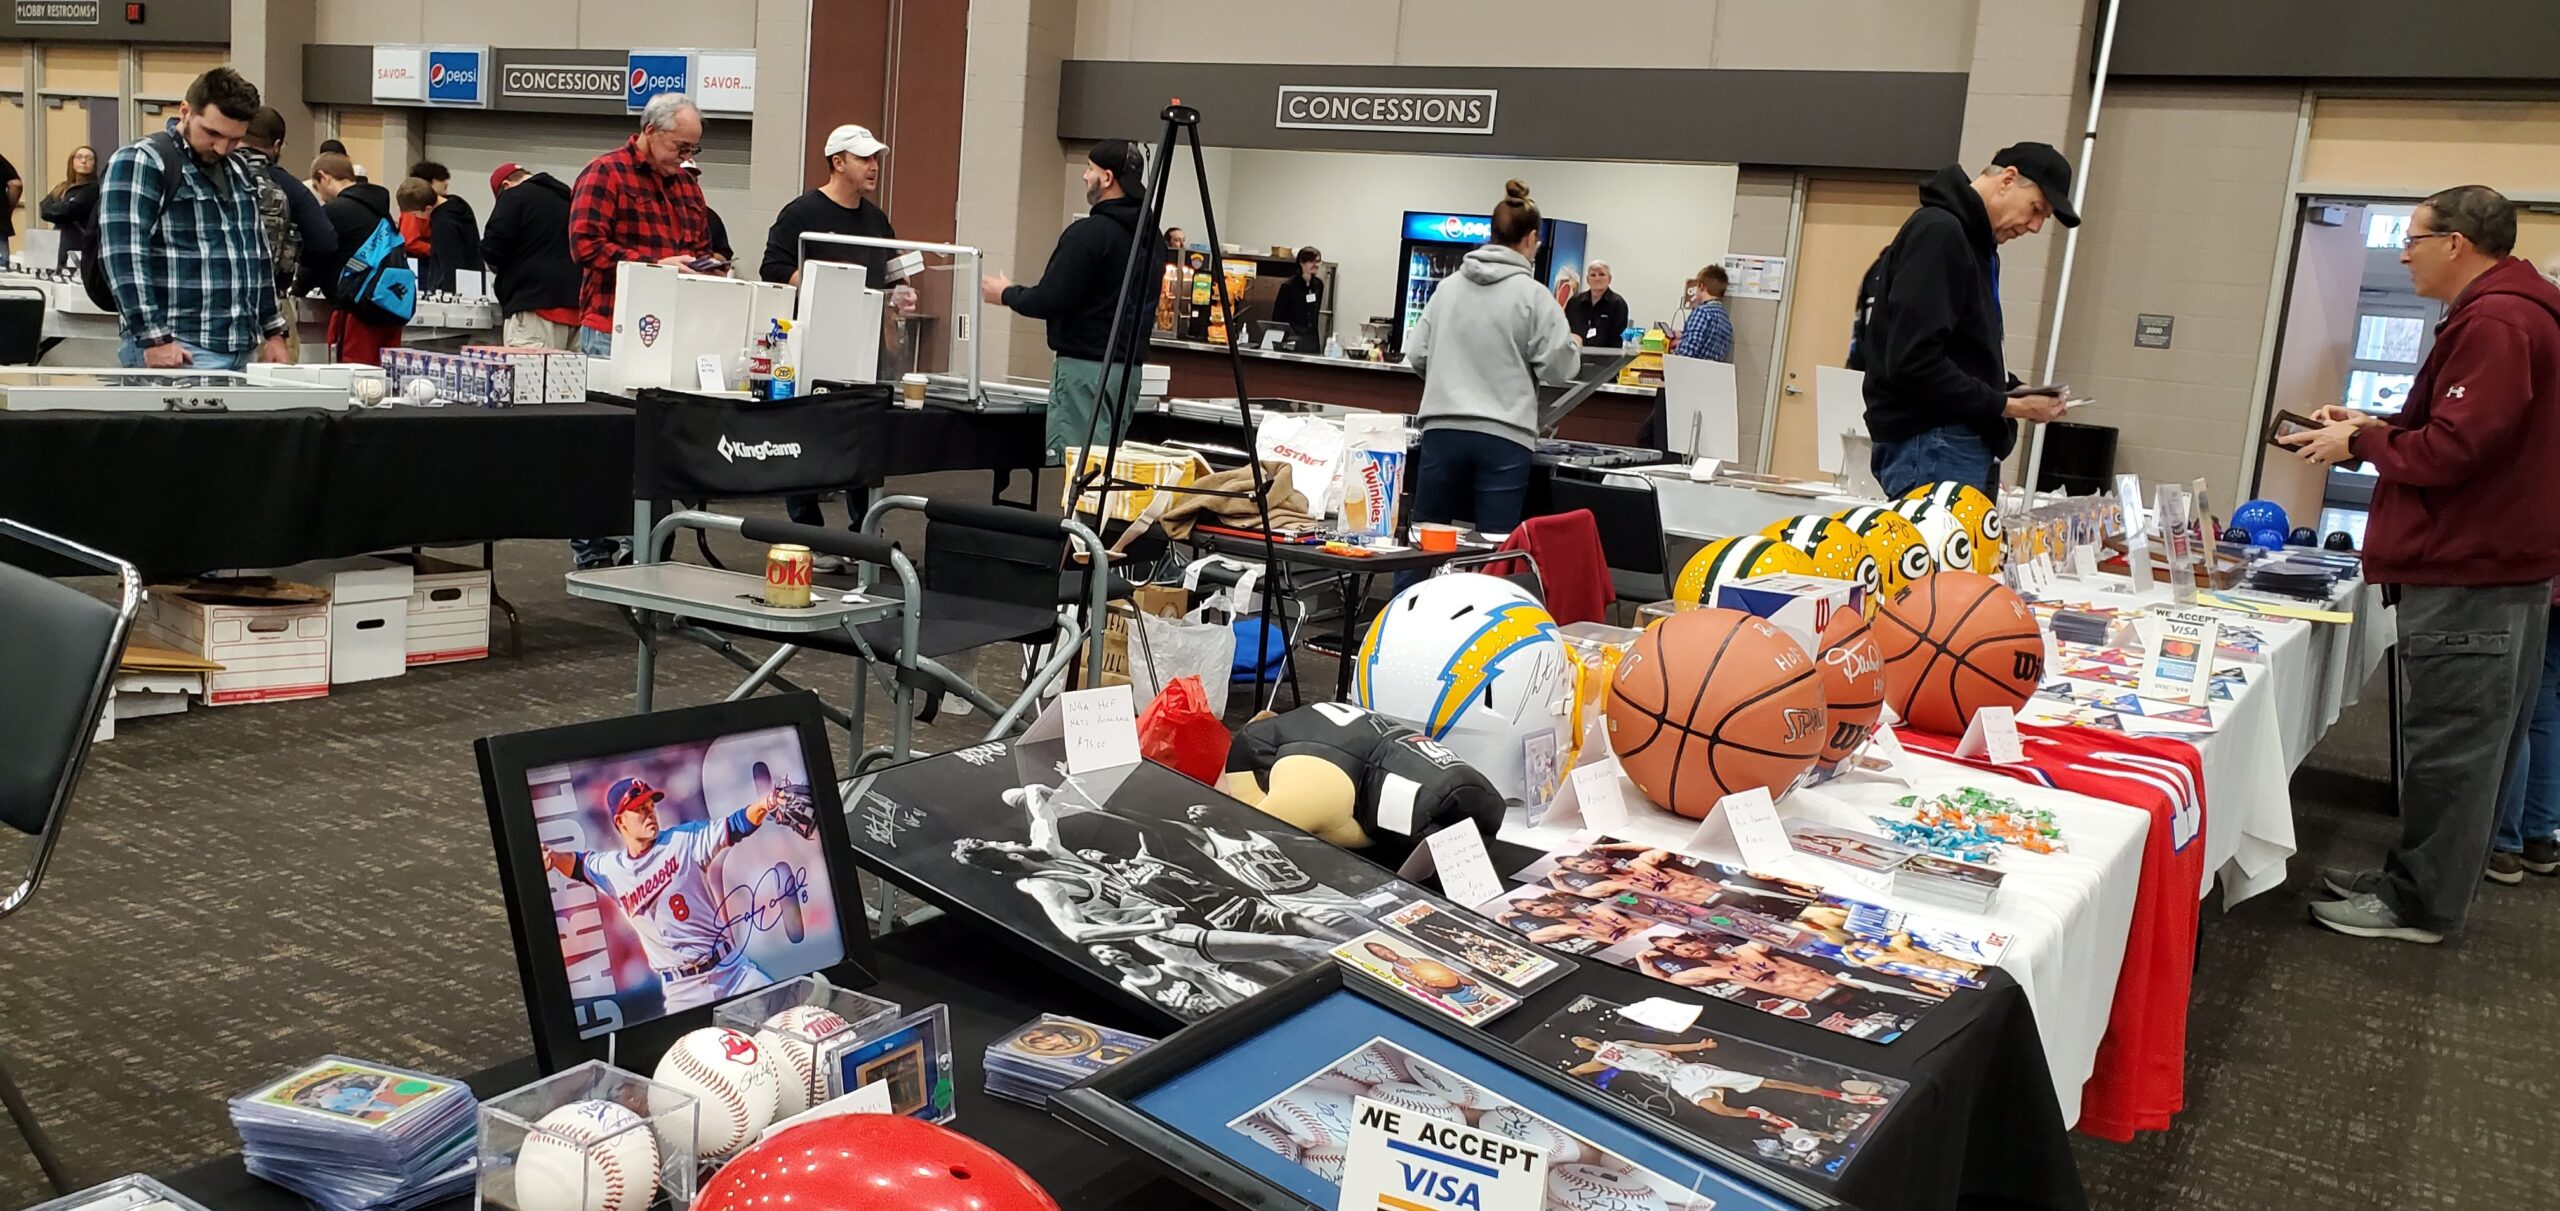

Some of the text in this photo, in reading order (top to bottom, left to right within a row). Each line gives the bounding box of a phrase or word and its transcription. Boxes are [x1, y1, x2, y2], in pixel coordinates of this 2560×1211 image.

[22, 4, 91, 17] LOBBY RESTROOMS
[445, 68, 477, 85] pepsi
[508, 71, 622, 91] CONCESSIONS
[648, 74, 686, 92] pepsi
[1288, 95, 1483, 123] CONCESSIONS
[731, 440, 802, 461] KingCamp
[1271, 444, 1328, 467] OSTNET
[1361, 460, 1384, 524] Twinkies
[2156, 609, 2219, 625] WE ACCEPT
[2171, 624, 2200, 637] VISA
[2154, 683, 2190, 693] DISCVER
[619, 852, 680, 913] Minnesota
[1256, 861, 1304, 883] 15
[668, 894, 691, 923] 8
[1417, 1122, 1539, 1173] ACCEPT
[1396, 1159, 1481, 1211] VISA
